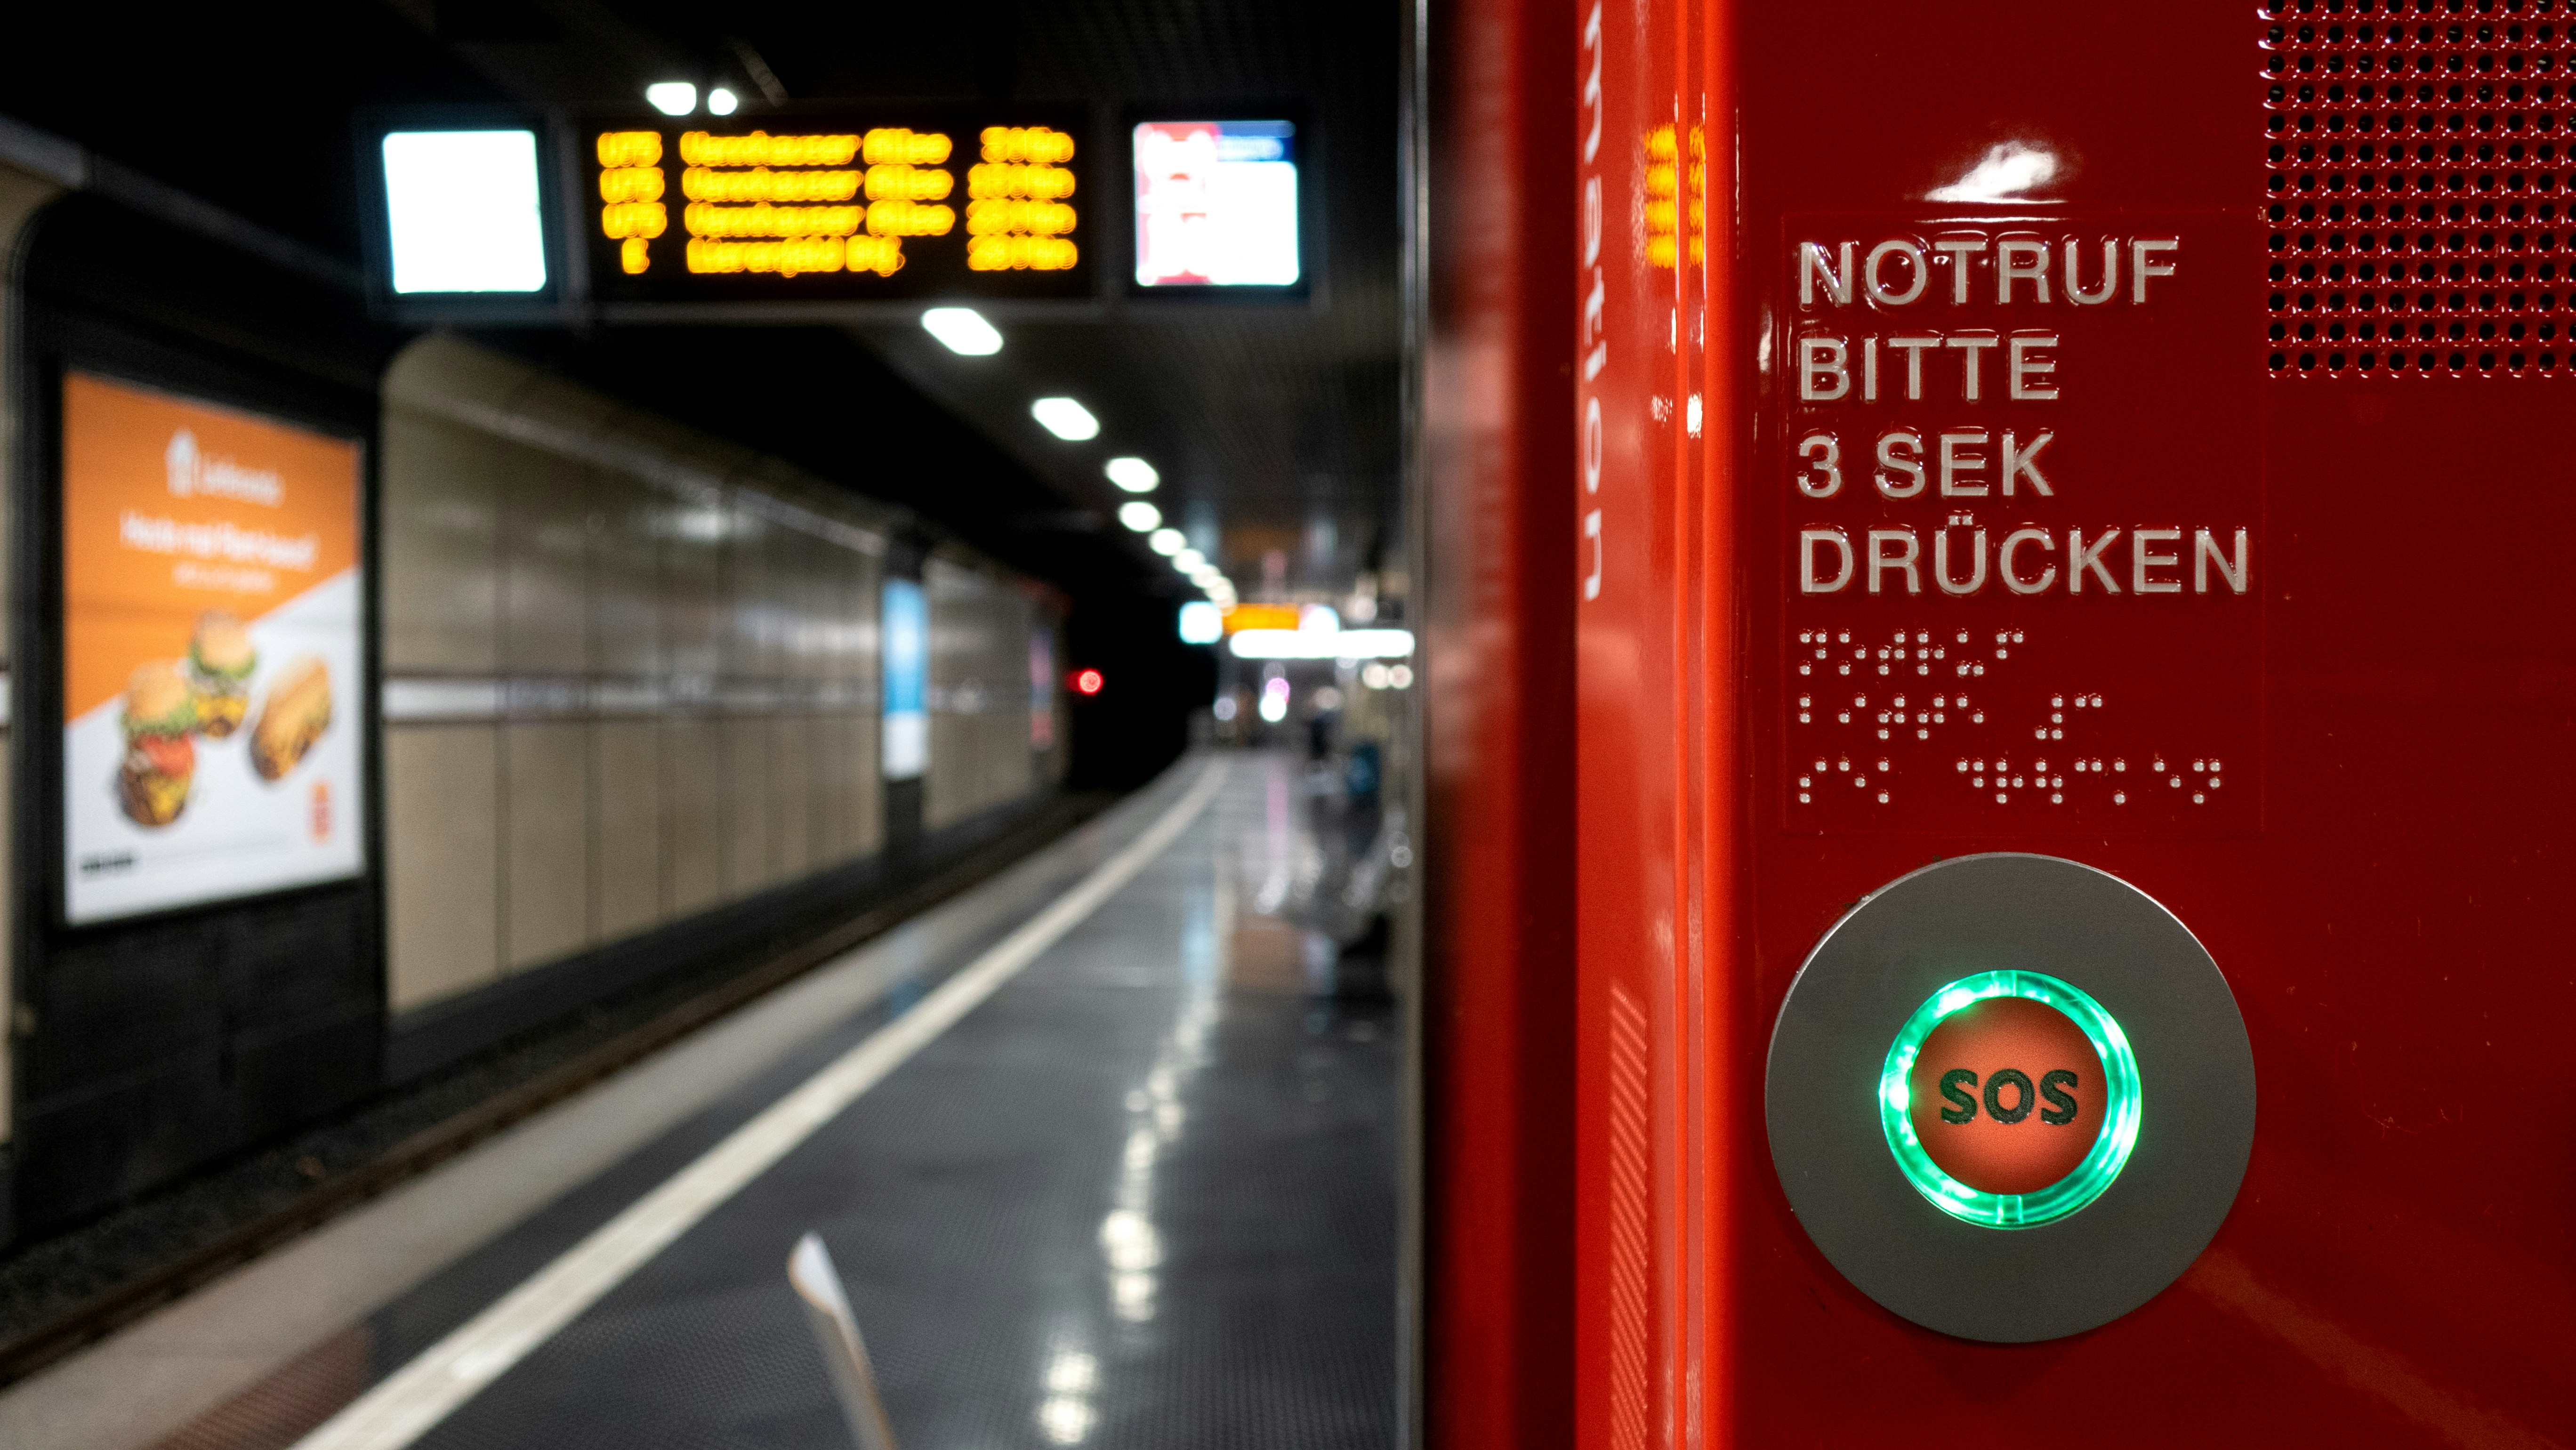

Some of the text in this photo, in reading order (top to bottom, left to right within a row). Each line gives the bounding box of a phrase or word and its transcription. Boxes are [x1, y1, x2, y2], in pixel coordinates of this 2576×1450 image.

[1798, 240, 2179, 306] NOTRUF
[1799, 337, 2059, 401] BITTE
[1796, 432, 2055, 498] 3 SEK
[1799, 514, 2247, 594] DRÜCKEN
[1939, 1068, 2078, 1126] SOS
